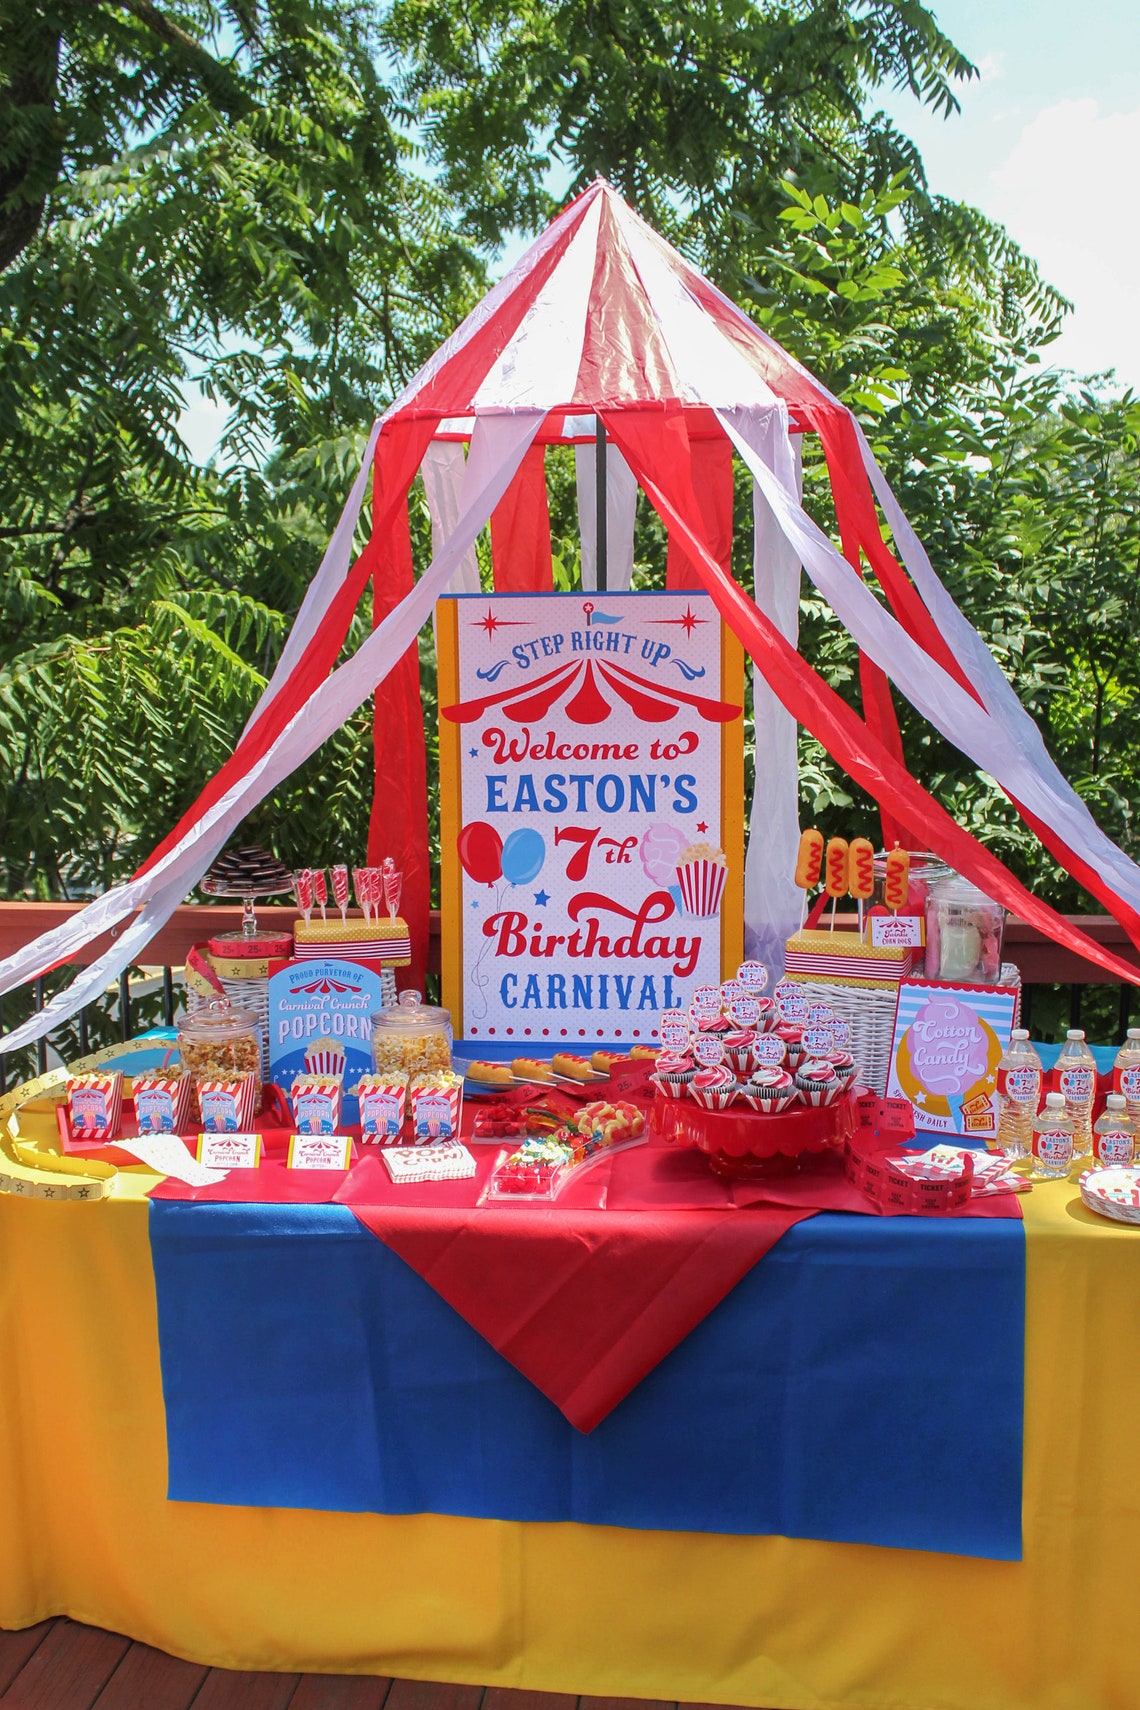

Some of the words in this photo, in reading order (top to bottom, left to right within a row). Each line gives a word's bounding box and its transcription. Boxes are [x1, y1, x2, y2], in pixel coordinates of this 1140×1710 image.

[511, 632, 565, 669] STEP
[571, 630, 638, 653] RIGHT
[641, 639, 671, 668] UP
[481, 727, 640, 765] Welcome
[649, 731, 700, 762] to
[485, 774, 699, 814] EASTON'S
[554, 826, 639, 882] 7th
[482, 890, 702, 978] Birthday
[289, 970, 314, 984] PROUD
[315, 968, 352, 980] PURVEYOR
[353, 974, 364, 983] OF
[279, 995, 331, 1011] Carnival
[330, 994, 372, 1010] Crunch
[499, 973, 683, 1011] CARNIVAL
[279, 1012, 373, 1046] POPCORN
[912, 1020, 982, 1043] Cotton
[913, 1039, 986, 1077] Candy
[300, 1109, 330, 1119] POPCORN
[366, 1109, 397, 1119] POPCORN
[419, 1111, 449, 1121] POPCORN
[912, 1109, 926, 1122] ESH
[926, 1117, 948, 1128] DAILY
[888, 1175, 909, 1188] TICKET
